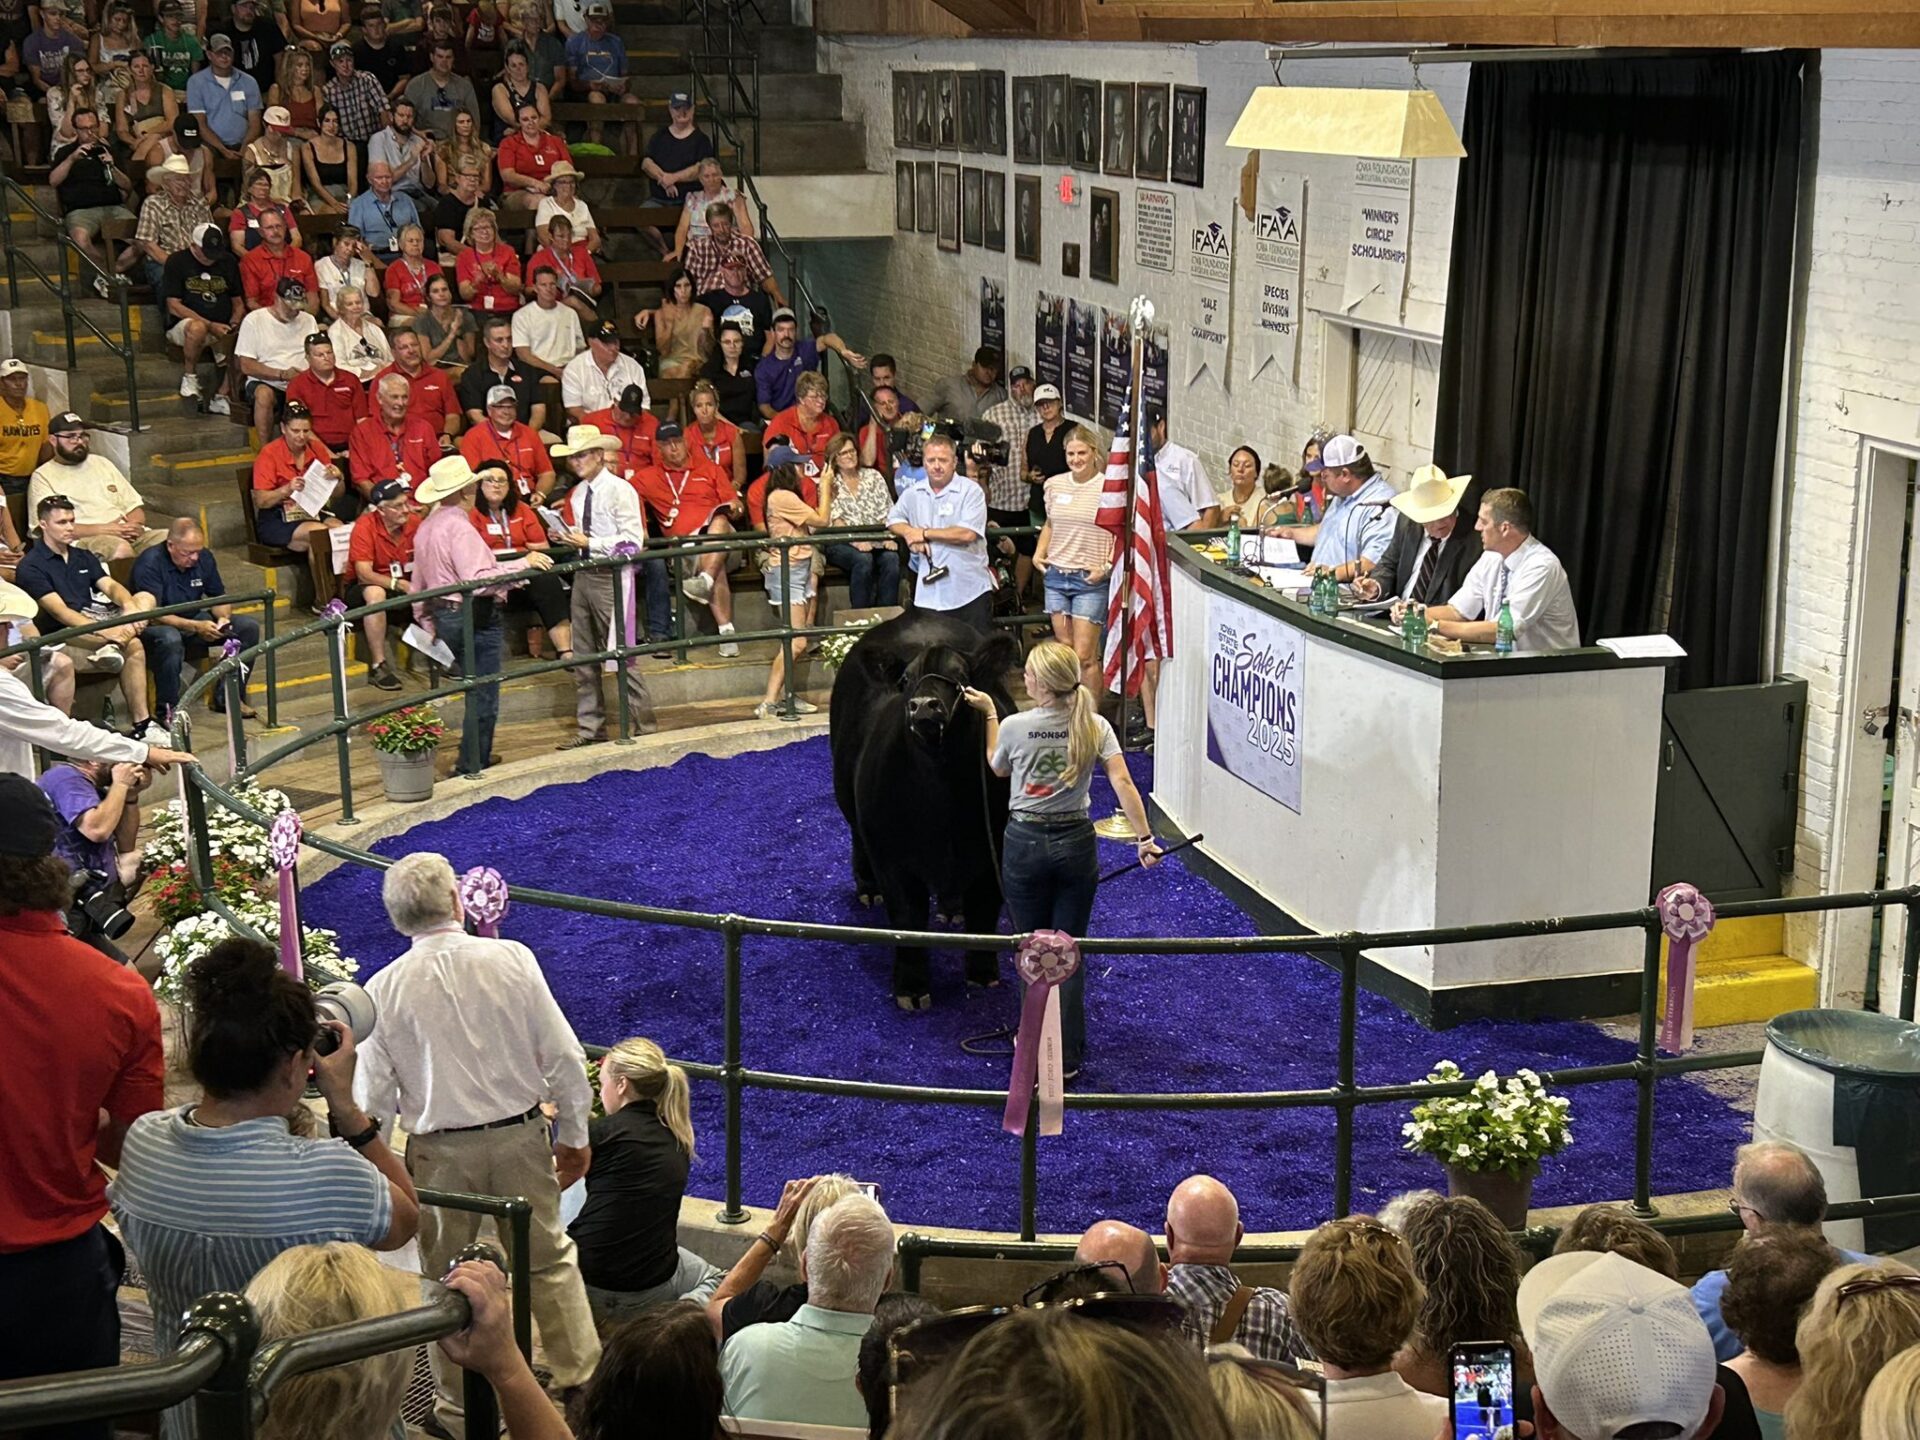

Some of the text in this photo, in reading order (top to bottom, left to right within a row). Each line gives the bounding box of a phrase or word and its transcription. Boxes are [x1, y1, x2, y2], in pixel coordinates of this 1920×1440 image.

[1352, 243, 1406, 264] SCHOLARSHIPS
[1264, 284, 1289, 301] SPECIES
[1262, 301, 1289, 318] DIVISION
[1220, 623, 1237, 639] IOWA
[1218, 632, 1239, 650] STATE
[1235, 632, 1295, 682] Sale of
[1213, 652, 1296, 735] CHAMPIONS
[1028, 730, 1069, 739] SPONSO
[1247, 711, 1295, 767] 2025
